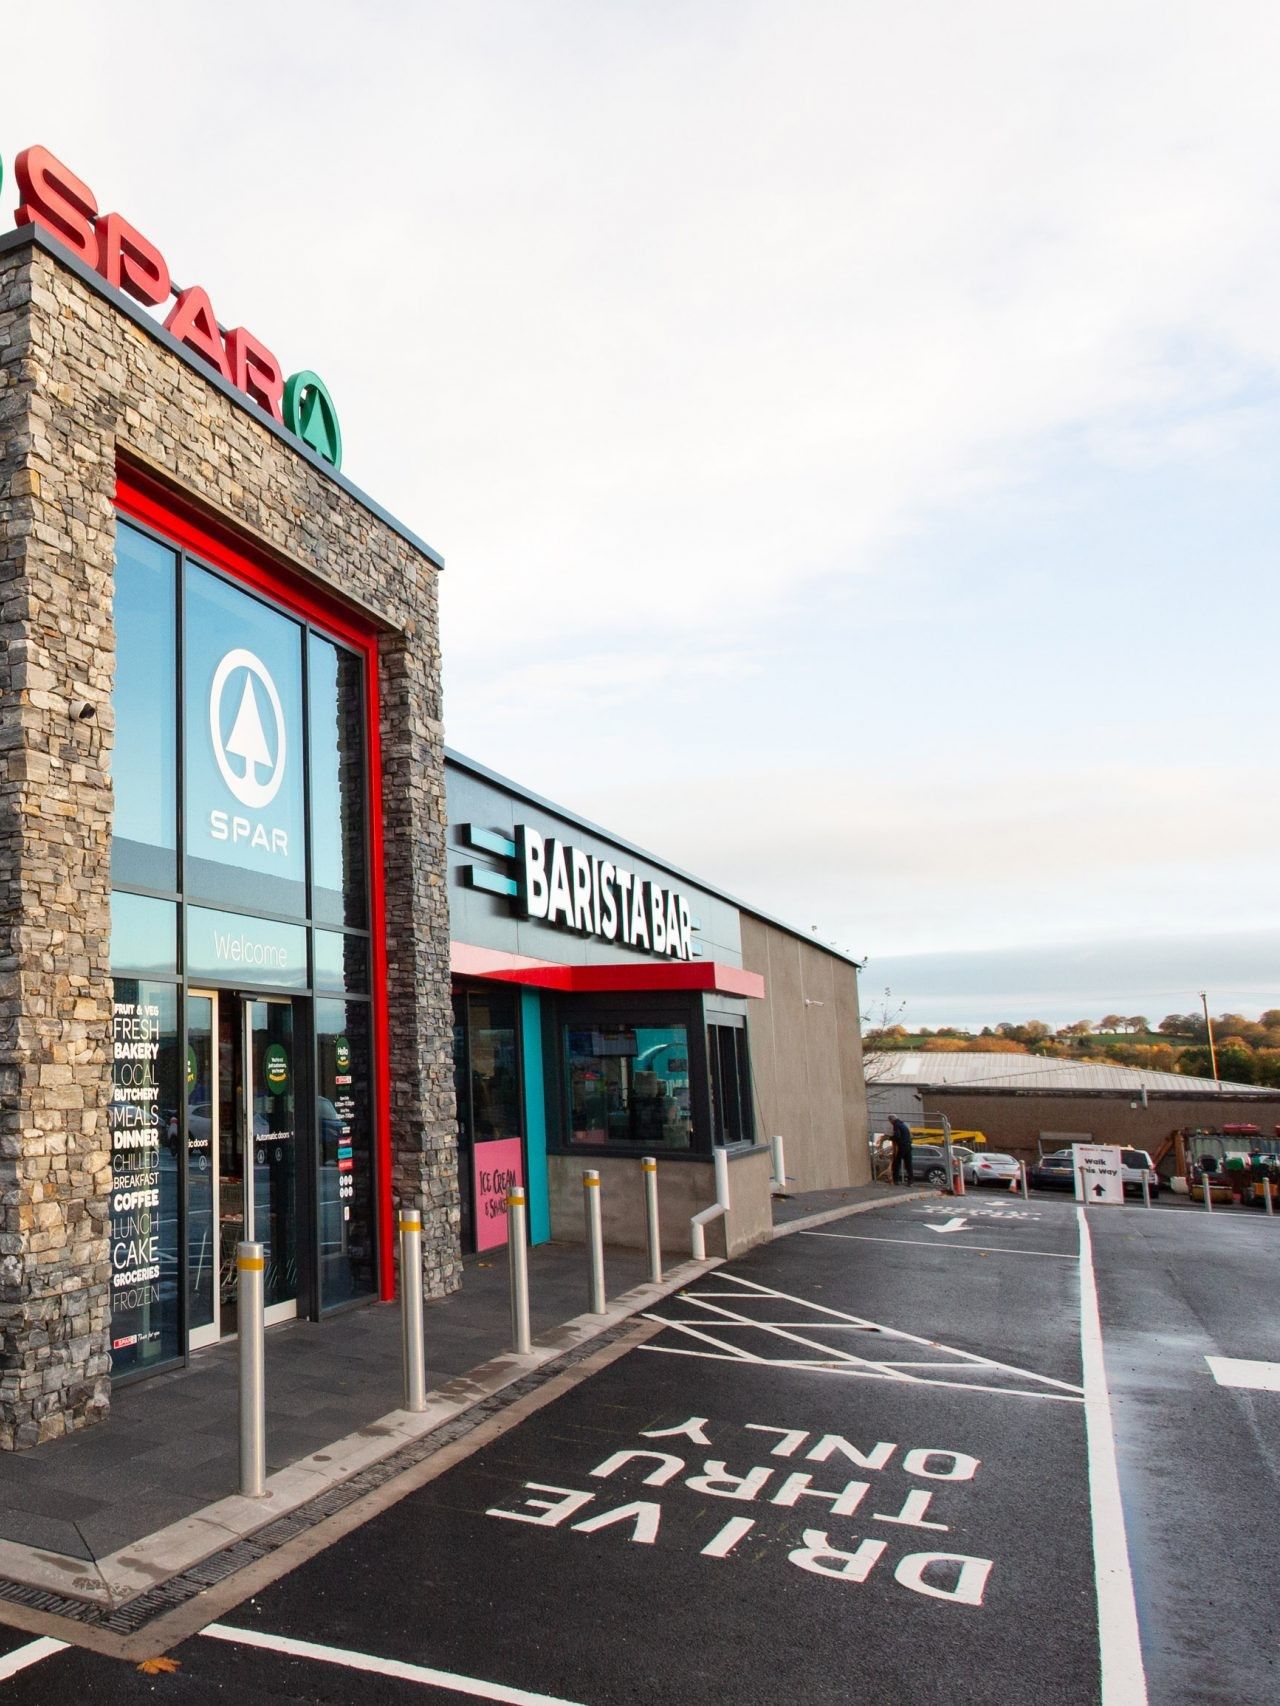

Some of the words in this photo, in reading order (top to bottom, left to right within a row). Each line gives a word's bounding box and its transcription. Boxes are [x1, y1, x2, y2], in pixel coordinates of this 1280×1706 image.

[14, 144, 285, 427] SPAR
[210, 809, 289, 857] SPAR
[514, 824, 650, 949] BARISTA
[645, 881, 693, 961] BAR
[214, 929, 288, 969] Welcome
[114, 1003, 135, 1016] FRUIT
[136, 1004, 143, 1016] &
[144, 1005, 160, 1016] VEG
[113, 1018, 159, 1040] FRESH
[114, 1042, 159, 1060] BAKERY
[114, 1063, 159, 1086] LOCAL
[114, 1087, 159, 1101] BUTCHERY
[113, 1104, 159, 1128] MEALS
[113, 1128, 159, 1149] DINNER
[194, 1139, 208, 1147] doors
[113, 1151, 159, 1172] CHILLED
[1098, 1168, 1118, 1176] Way
[113, 1172, 159, 1190] BREAKFAST
[480, 1170, 492, 1196] ICE
[493, 1168, 517, 1195] CREAM
[113, 1189, 160, 1212] COFFEE
[113, 1212, 159, 1240] LUNCH
[113, 1236, 159, 1269] CAKE
[113, 1265, 160, 1288] GROCERIES
[113, 1284, 160, 1312] FROZEN
[639, 1417, 981, 1481] ONLY
[588, 1450, 949, 1531] THRU
[485, 1482, 994, 1606] DRIVE
